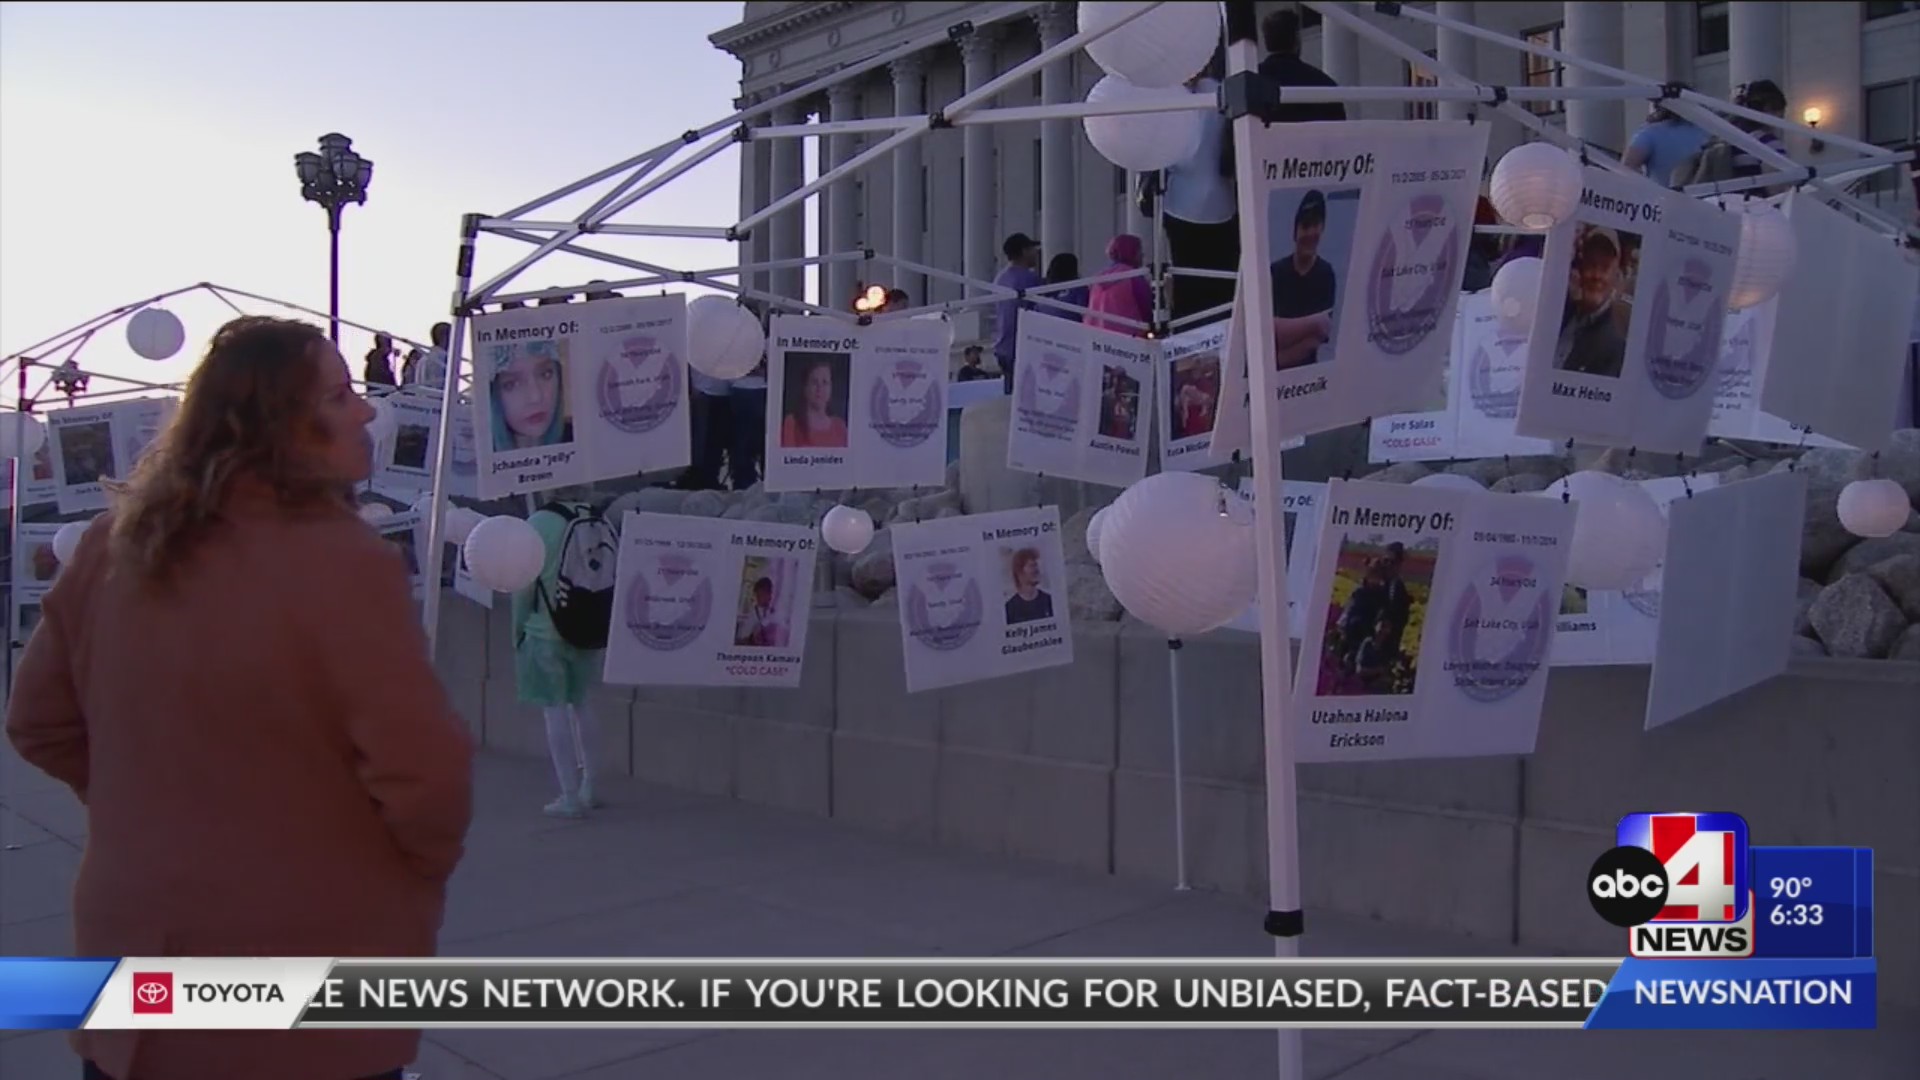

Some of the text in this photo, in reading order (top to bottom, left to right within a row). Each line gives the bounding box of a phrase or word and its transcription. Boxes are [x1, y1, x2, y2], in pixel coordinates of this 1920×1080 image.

[1281, 156, 1349, 182] Memory
[1353, 152, 1376, 174] Of:
[1580, 187, 1662, 224] Memory Of:
[477, 320, 580, 343] In Memory Of:
[777, 337, 860, 351] In Memory Of:
[1103, 344, 1138, 363] Memory
[1552, 382, 1576, 398] Max
[783, 455, 809, 465] Linda
[518, 471, 554, 484] Brown
[1331, 505, 1455, 533] In Memory Of:
[982, 530, 994, 542] In
[996, 525, 1040, 541] Memory
[730, 533, 816, 552] In Memory Of:
[1005, 623, 1058, 639] Kelly James
[1552, 621, 1597, 632] illiams
[1312, 709, 1361, 724] Utahna
[1330, 733, 1385, 748] Erickson
